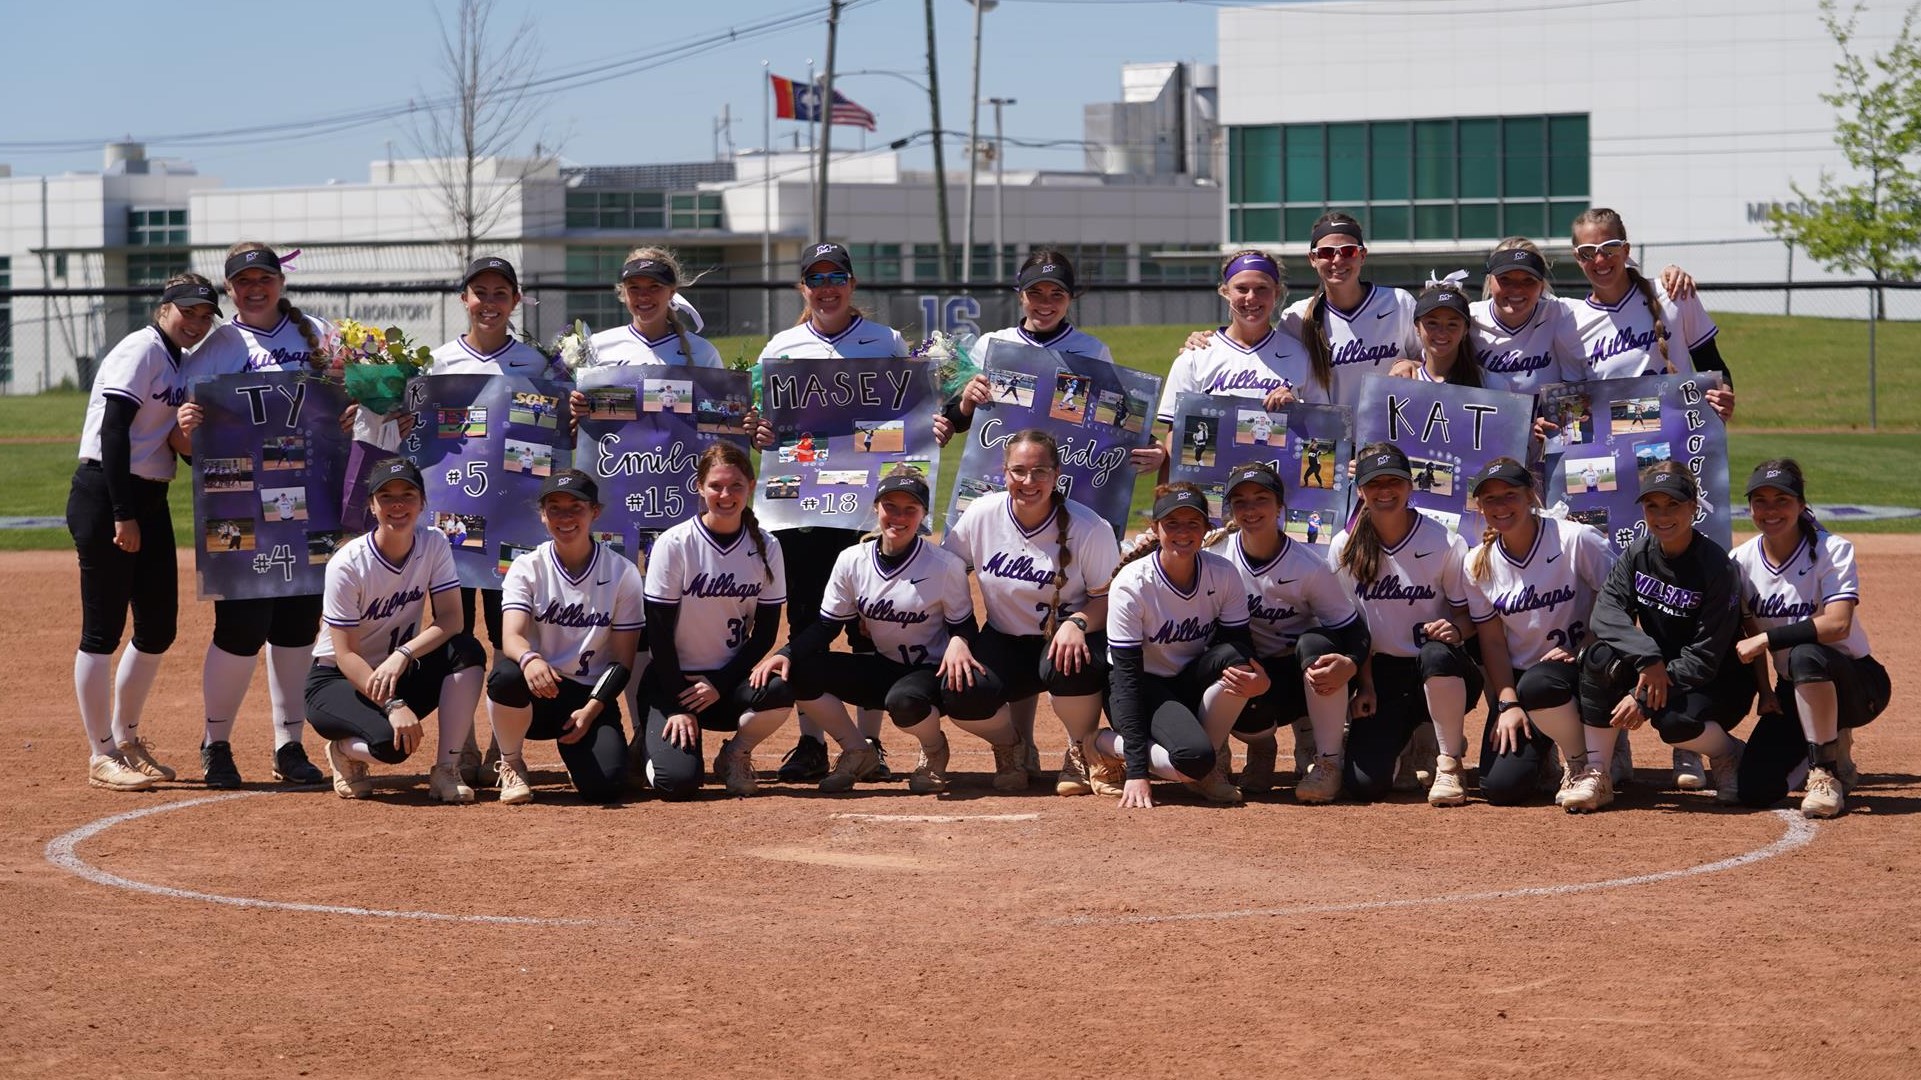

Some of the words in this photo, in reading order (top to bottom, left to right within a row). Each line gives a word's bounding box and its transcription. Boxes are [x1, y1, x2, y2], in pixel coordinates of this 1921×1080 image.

[347, 301, 434, 320] ABORATORY
[918, 295, 981, 340] 16
[241, 347, 311, 373] Millsap
[235, 382, 306, 429] TY
[770, 370, 912, 411] MASEY
[1388, 395, 1497, 450] KAT
[979, 418, 1126, 488] Cidy
[626, 487, 684, 517] #15
[801, 492, 858, 515] #18
[253, 545, 296, 582] #4
[982, 552, 1056, 590] Millsap
[682, 573, 763, 603] Millsaps
[1355, 575, 1436, 606] Millsaps
[1493, 584, 1576, 616] Millsaps
[534, 600, 612, 628] Millsaps
[857, 596, 930, 629] Millsaps
[1247, 593, 1300, 625] lsaps
[1547, 621, 1586, 649] 26
[899, 644, 930, 667] 12
